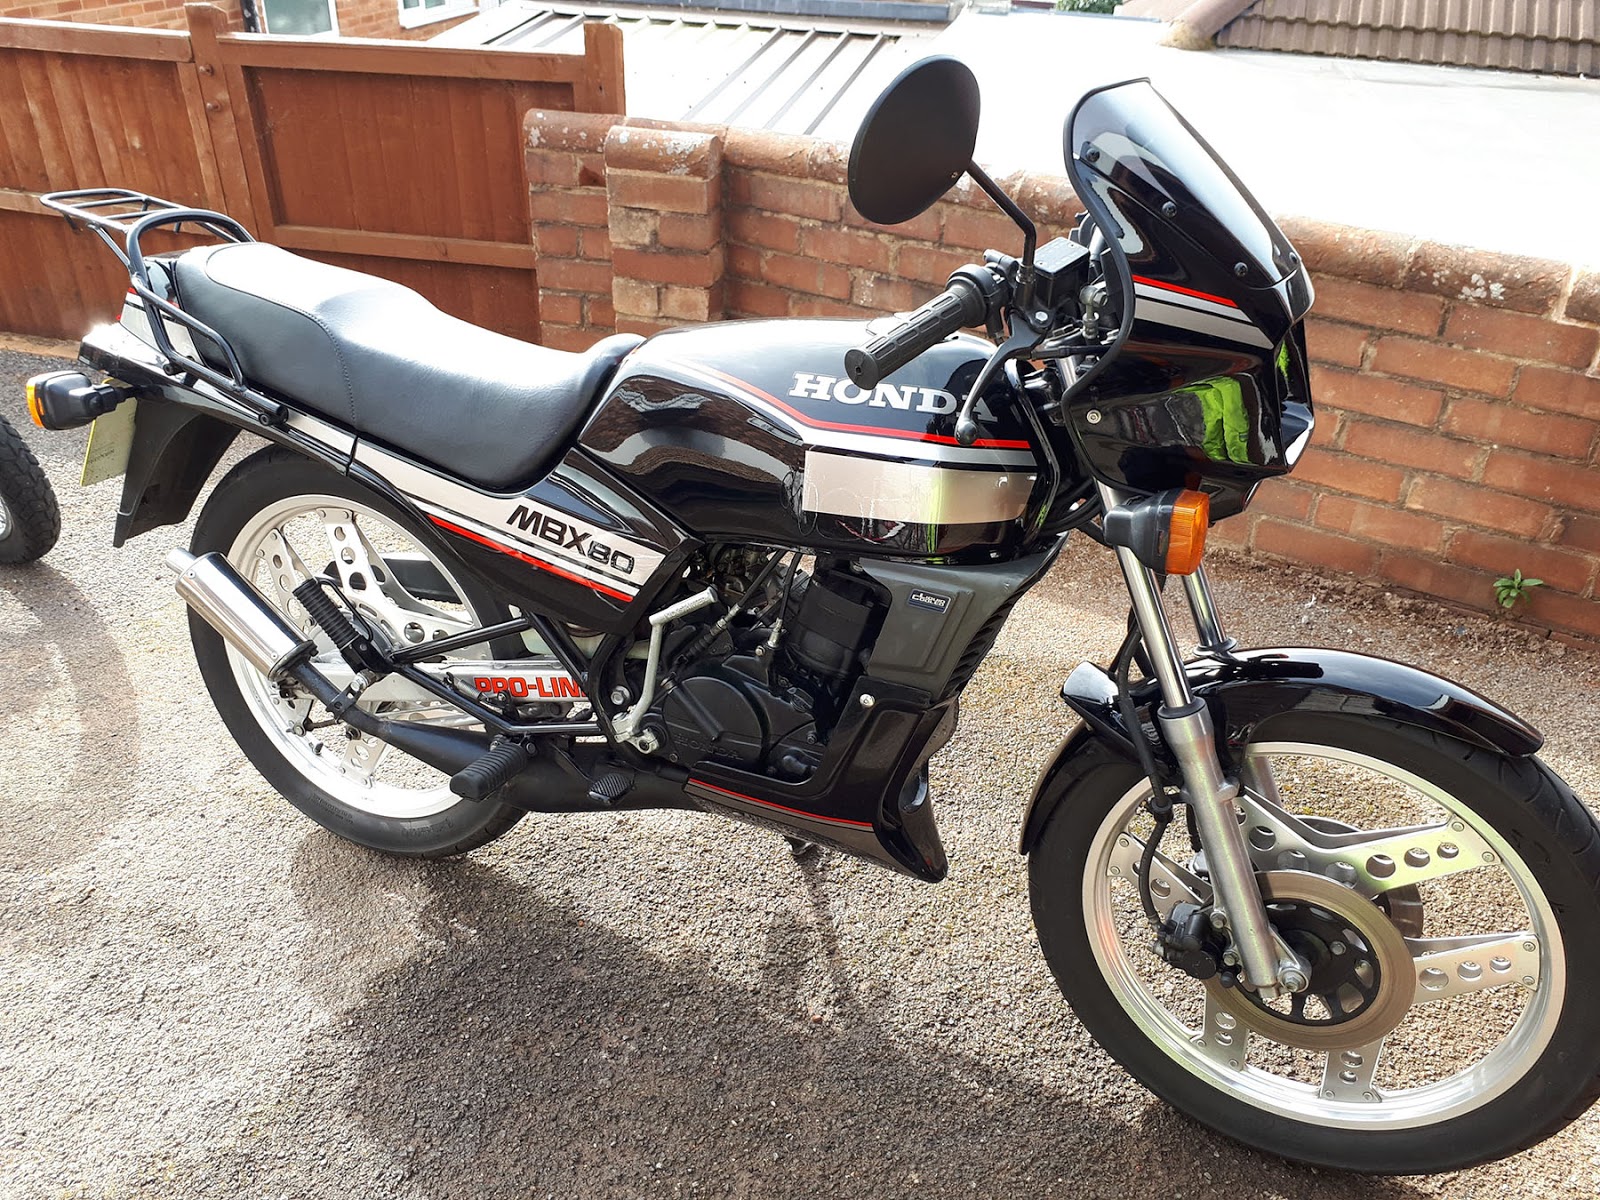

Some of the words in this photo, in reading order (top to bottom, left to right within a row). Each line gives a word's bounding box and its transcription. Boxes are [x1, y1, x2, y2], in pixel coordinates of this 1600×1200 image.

[787, 371, 999, 423] HONDA
[506, 503, 635, 575] MBX80
[473, 676, 588, 698] PRO-LIN
